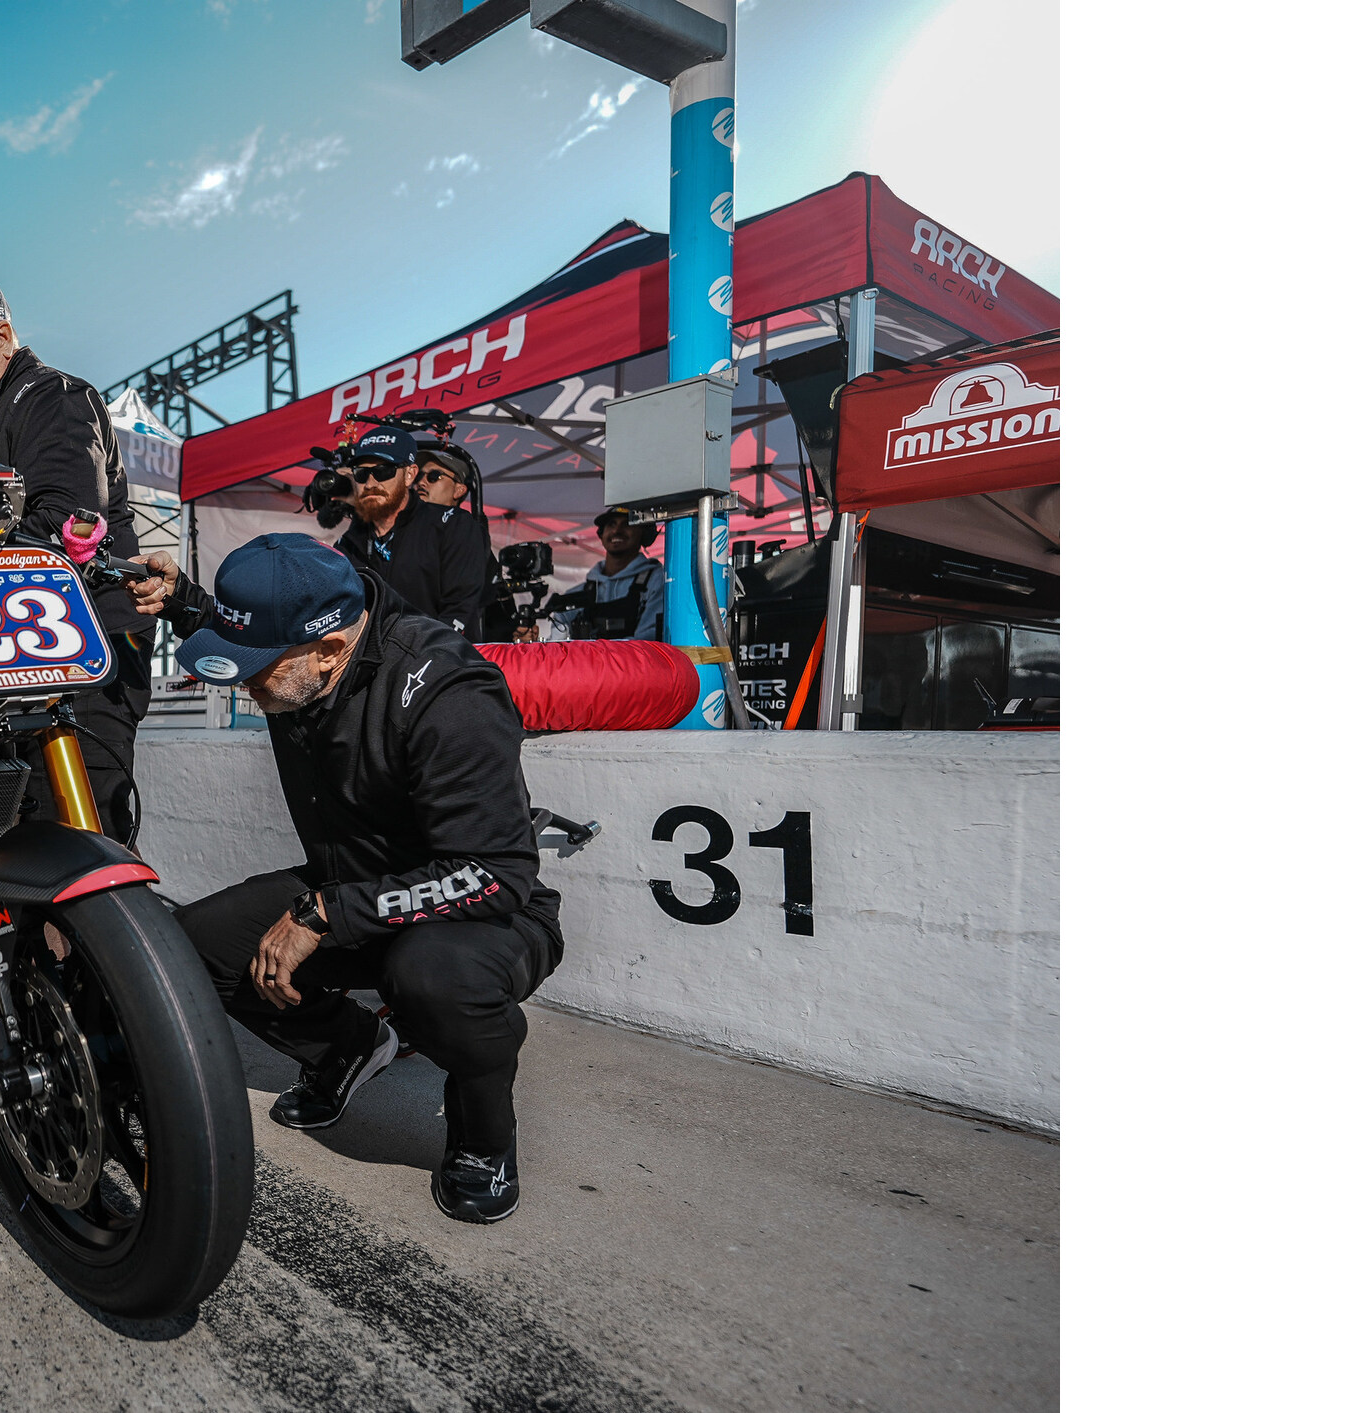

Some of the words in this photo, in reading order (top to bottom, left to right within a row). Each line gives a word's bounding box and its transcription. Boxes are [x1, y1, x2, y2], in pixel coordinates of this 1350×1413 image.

[910, 218, 1006, 298] ARCH
[913, 263, 996, 311] RACING
[328, 313, 527, 424] ARCH
[360, 435, 396, 448] ARCH
[893, 407, 1060, 460] MISSION
[305, 609, 341, 634] SUTER
[739, 642, 790, 660] RCH
[377, 861, 493, 917] ARCH
[650, 804, 814, 937] 31
[388, 882, 500, 924] RACING
